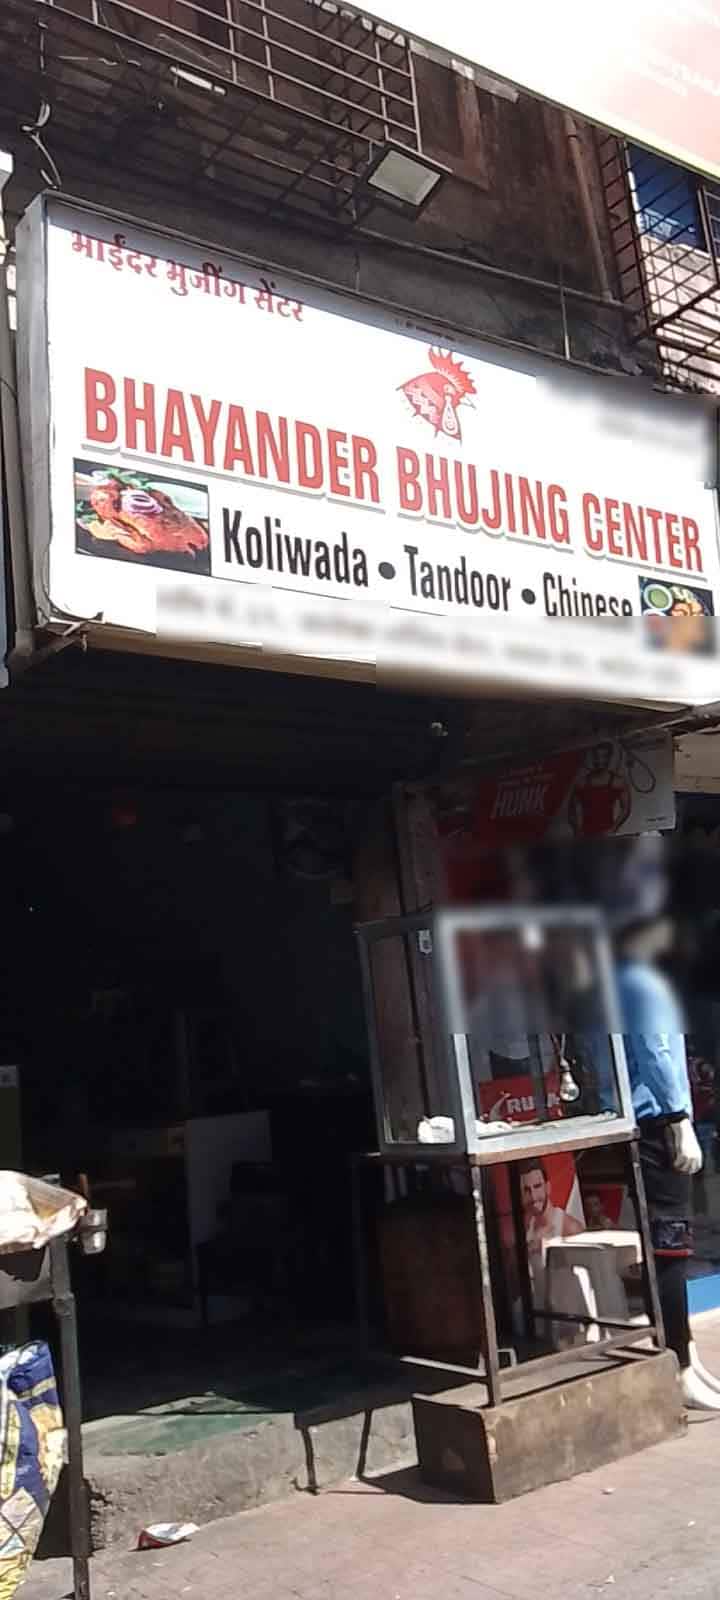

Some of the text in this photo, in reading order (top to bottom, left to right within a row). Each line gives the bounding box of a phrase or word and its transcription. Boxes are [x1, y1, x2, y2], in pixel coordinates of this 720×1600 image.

[254, 278, 305, 321] सेंटर
[85, 367, 704, 573] BHAYANDER BHUJING CENTER
[222, 507, 369, 587] Koliwada
[404, 545, 511, 612] Tandoor
